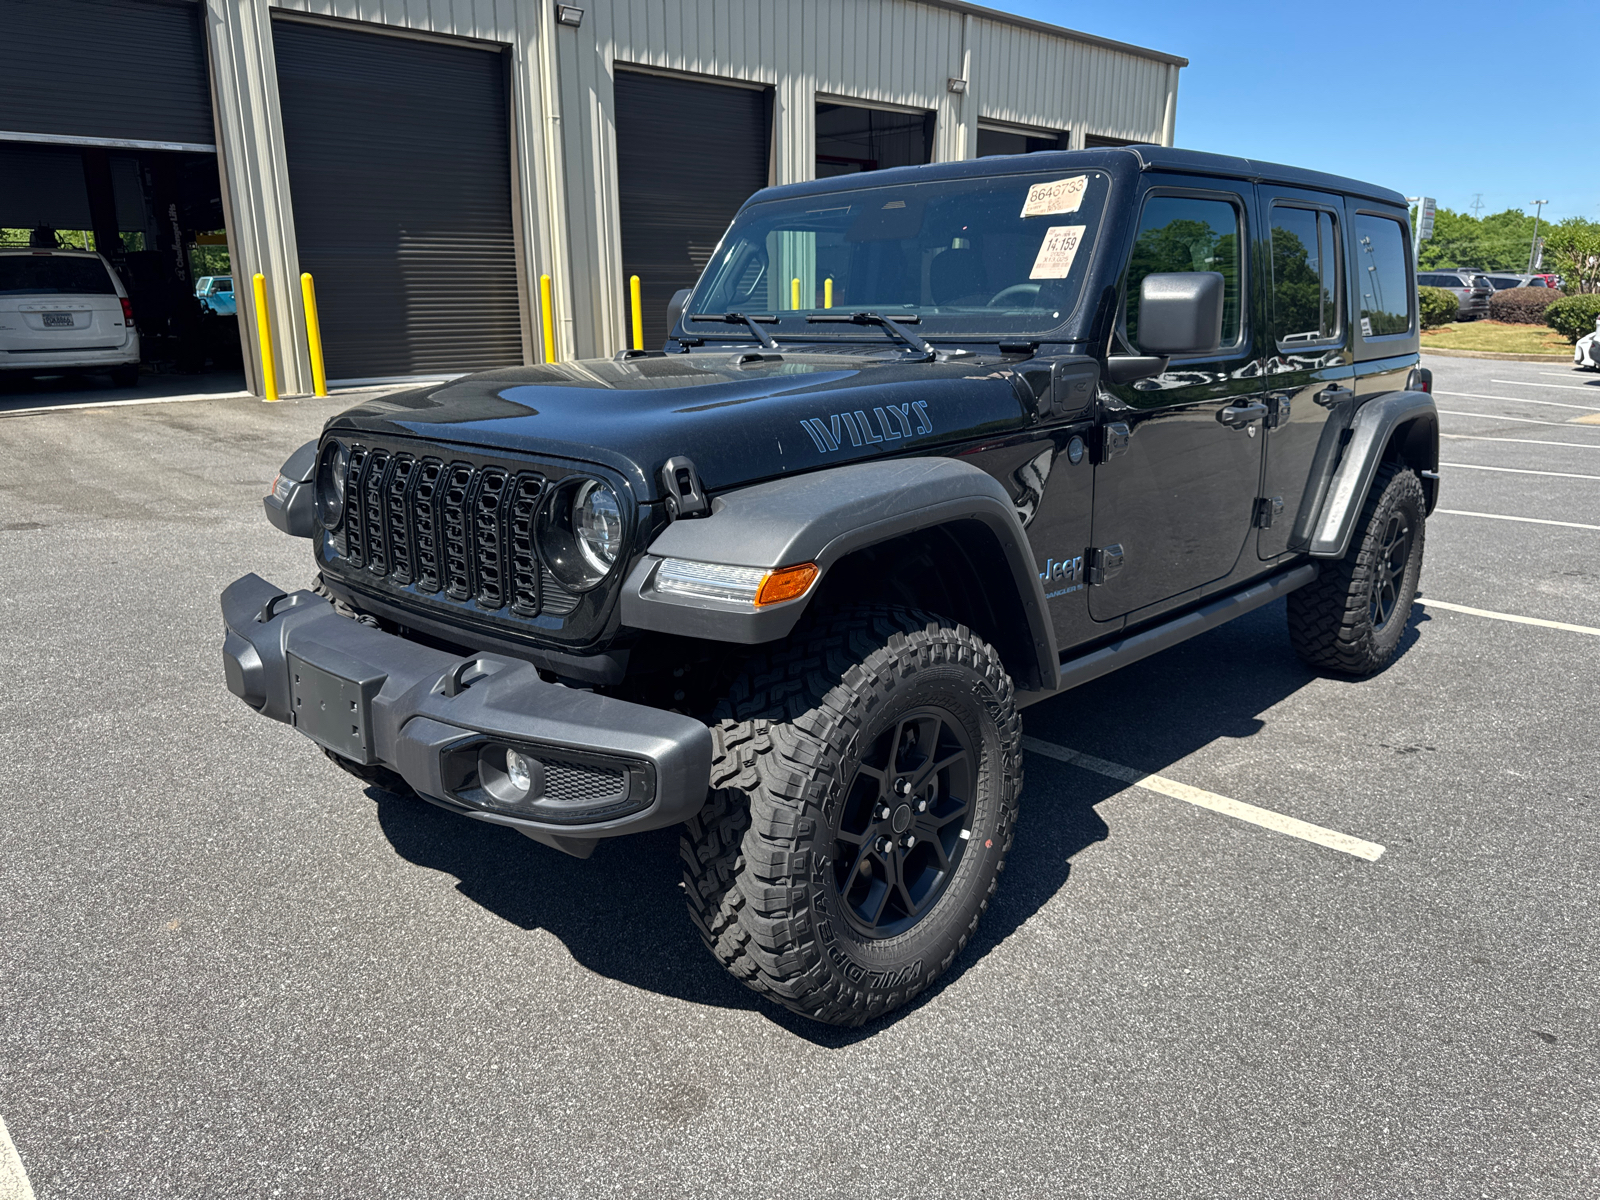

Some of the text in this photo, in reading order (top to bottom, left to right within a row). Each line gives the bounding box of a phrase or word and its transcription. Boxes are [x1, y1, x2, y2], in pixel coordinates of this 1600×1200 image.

[168, 203, 177, 221] Lifts
[171, 222, 184, 267] Challenger
[800, 400, 933, 453] WILLYS
[1039, 556, 1084, 585] Jeep
[811, 851, 923, 989] WILDPEAK
